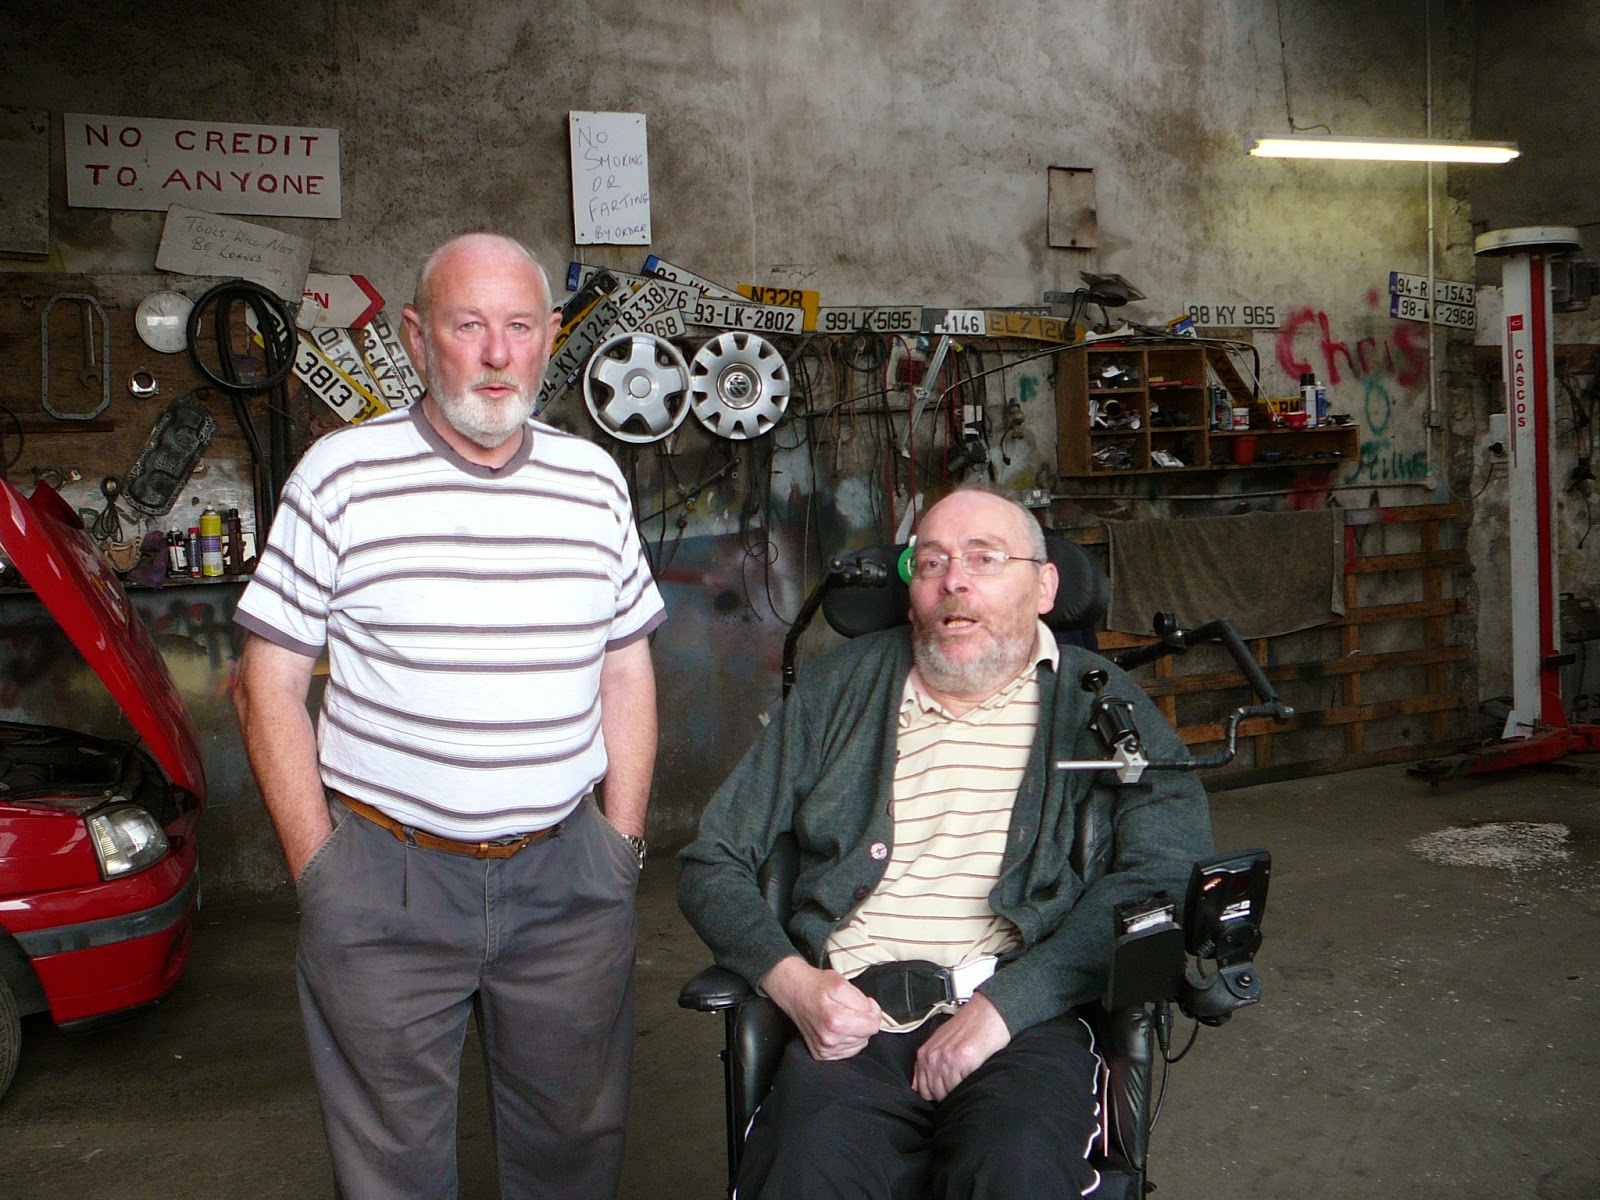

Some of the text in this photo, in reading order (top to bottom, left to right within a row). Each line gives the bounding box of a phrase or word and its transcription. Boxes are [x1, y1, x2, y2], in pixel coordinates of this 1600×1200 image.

[85, 124, 319, 156] NO CREDIT
[578, 127, 608, 148] NO
[584, 146, 643, 171] SMOKING
[85, 164, 324, 195] TO ANYONE
[592, 175, 622, 192] OR
[588, 193, 649, 222] FARTING
[191, 236, 213, 251] BE
[595, 225, 611, 241] BY
[1243, 306, 1276, 325] 965
[295, 351, 353, 408] 3813
[1514, 349, 1527, 428] CASCOS
